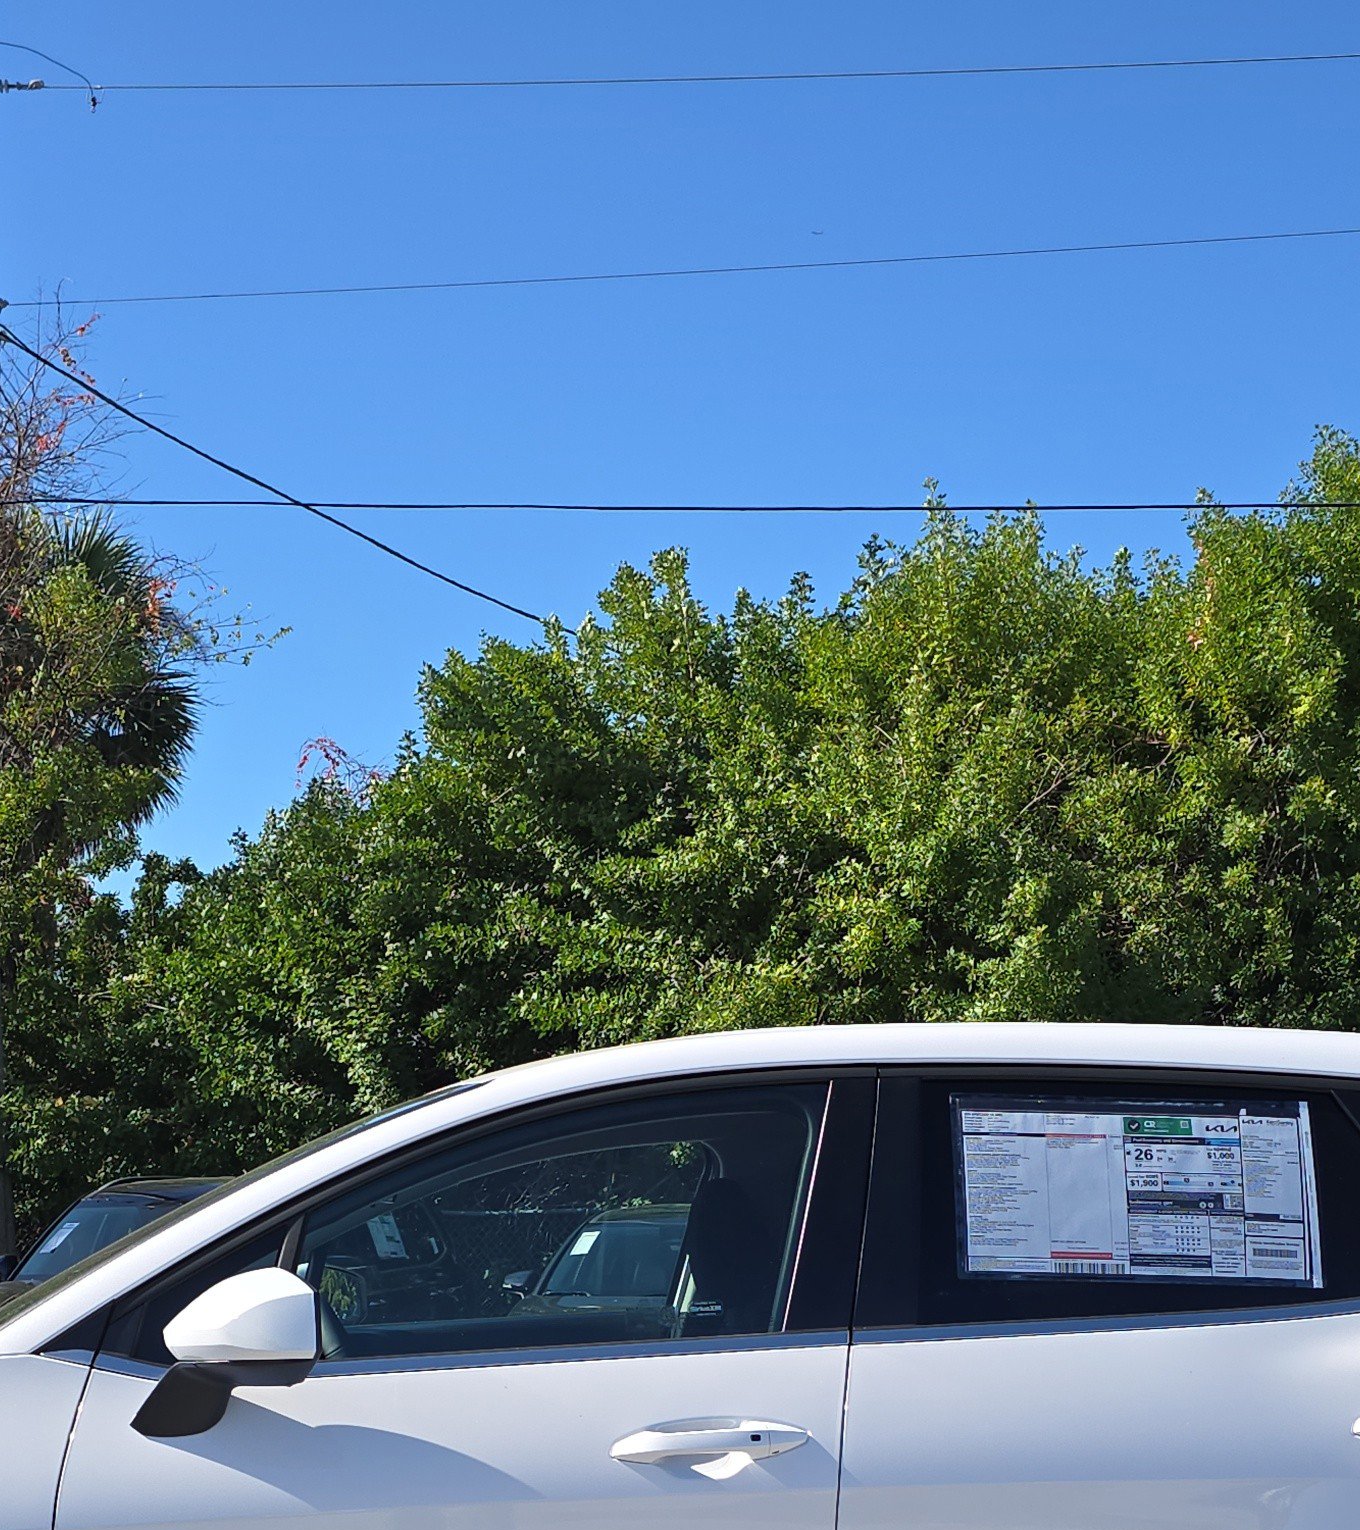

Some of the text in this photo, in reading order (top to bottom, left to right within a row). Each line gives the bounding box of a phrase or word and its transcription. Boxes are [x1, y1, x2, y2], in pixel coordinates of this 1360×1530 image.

[1205, 1124, 1238, 1133] KIA
[1134, 1148, 1154, 1161] 26
[1207, 1151, 1235, 1161] $1,000
[1130, 1179, 1159, 1188] $1,900
